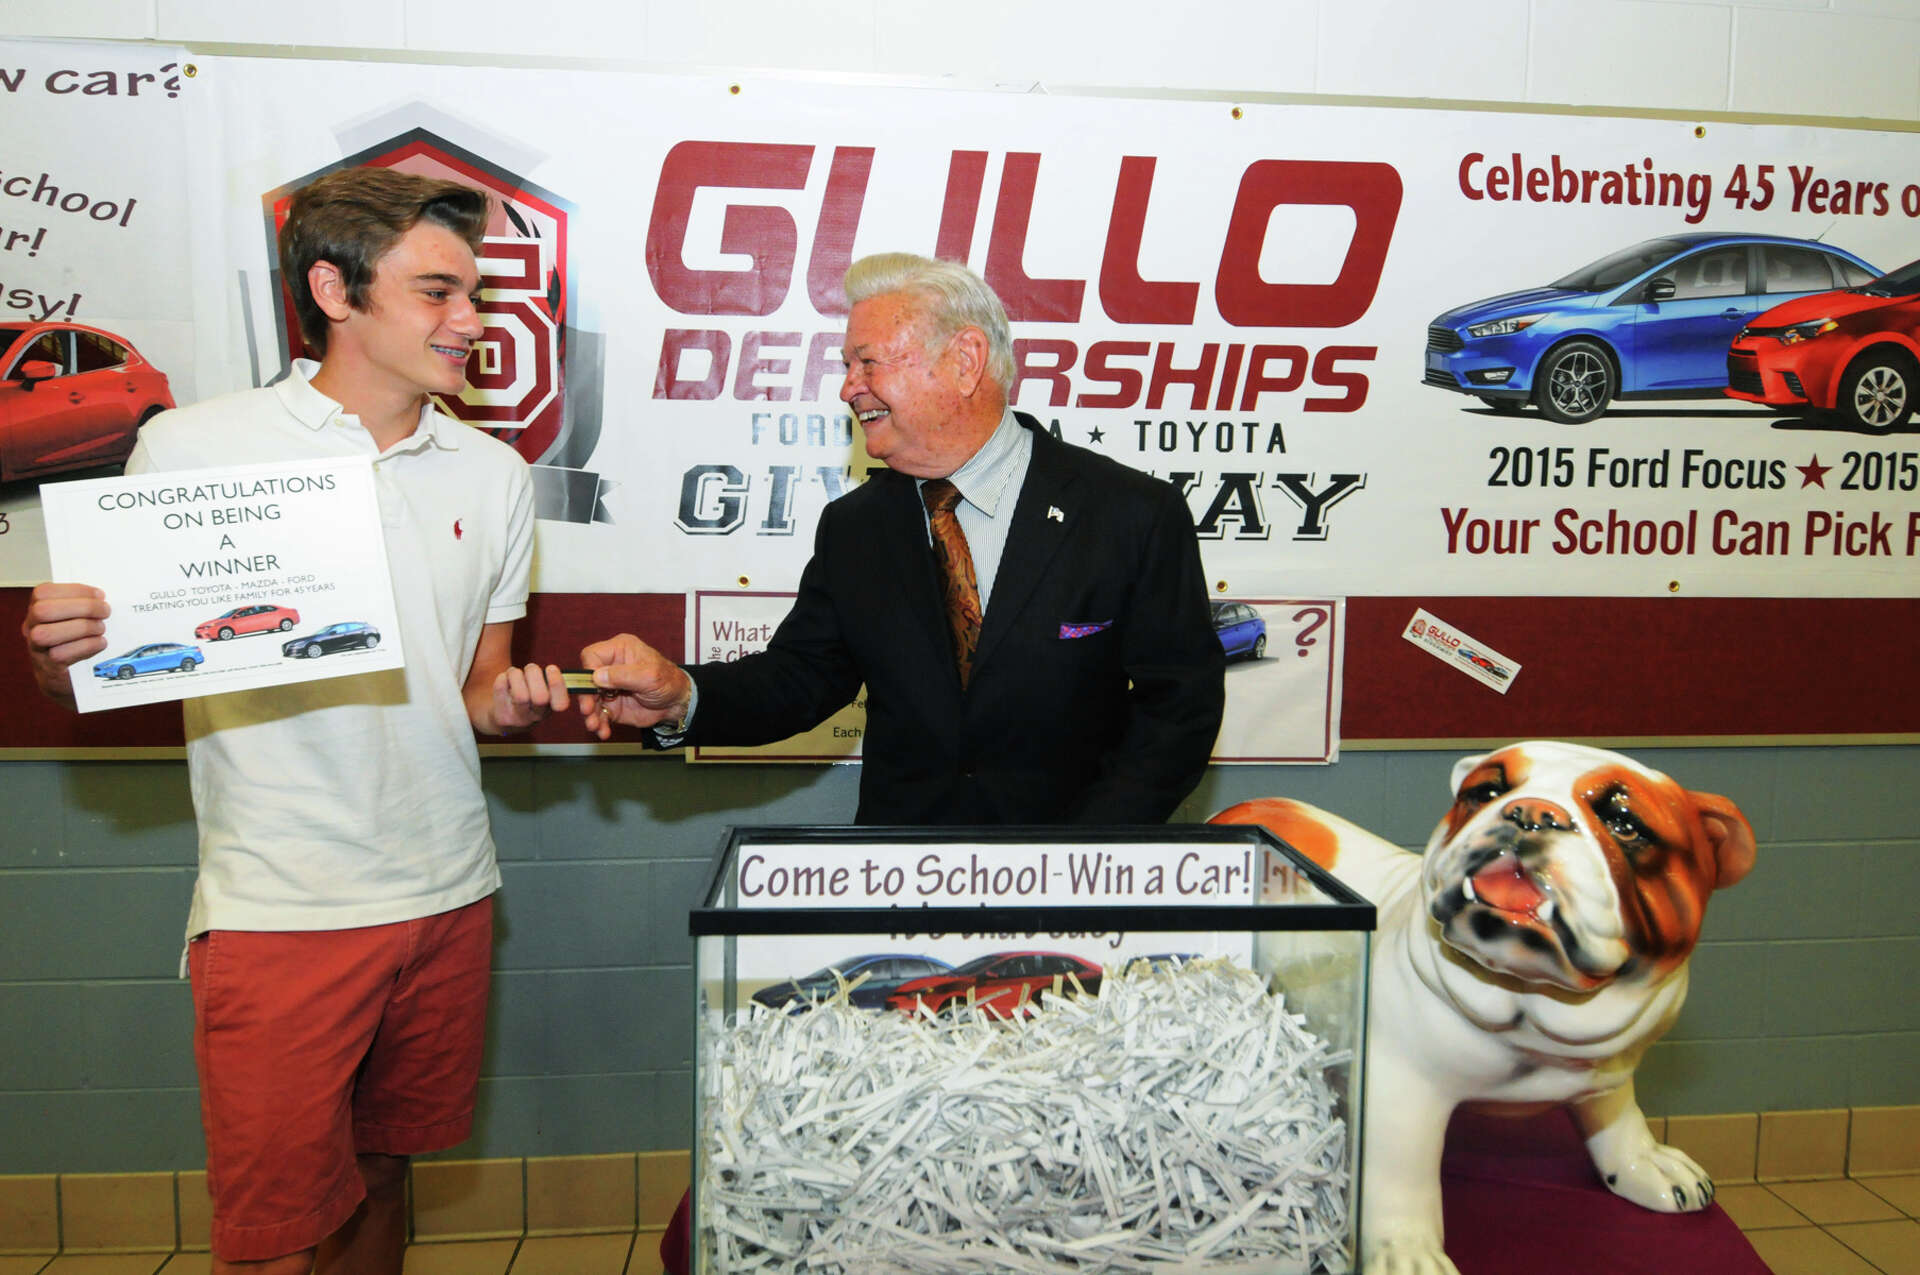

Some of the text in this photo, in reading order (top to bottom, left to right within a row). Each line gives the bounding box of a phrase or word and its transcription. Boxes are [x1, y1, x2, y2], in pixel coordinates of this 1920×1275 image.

[45, 63, 181, 98] car?
[0, 170, 137, 227] chool
[1459, 153, 1712, 224] Celebrating
[1724, 164, 1775, 212] 45
[1788, 165, 1889, 217] Years
[0, 227, 48, 257] r!
[645, 140, 1403, 329] GULLO
[0, 283, 82, 322] sy!
[751, 413, 1287, 453] FORD TOYOTA
[1488, 446, 1919, 491] 2015 Ford Focus 2015
[98, 474, 336, 511] CONGRATULATIONS
[163, 503, 281, 530] ON BEING
[1440, 507, 1540, 555] Your
[1552, 508, 1697, 555] School
[1712, 509, 1789, 556] Can
[1804, 511, 1893, 556] Pick
[219, 534, 236, 550] A
[180, 554, 281, 579] WINNER
[132, 599, 185, 612] TREATING
[186, 597, 209, 607] YOU
[210, 594, 232, 604] LIKE
[234, 590, 267, 601] FAMILY
[271, 588, 290, 597] FOR
[305, 582, 336, 592] YEARS
[150, 588, 186, 600] GULLO
[191, 584, 232, 595] TOYOTA
[240, 578, 278, 589] MAZDA
[287, 574, 316, 584] FORD
[712, 607, 1328, 657] What ?
[833, 727, 862, 738] Each
[740, 854, 850, 897] Come
[860, 859, 905, 896] to
[1144, 865, 1164, 895] a
[1176, 851, 1250, 896] Car!
